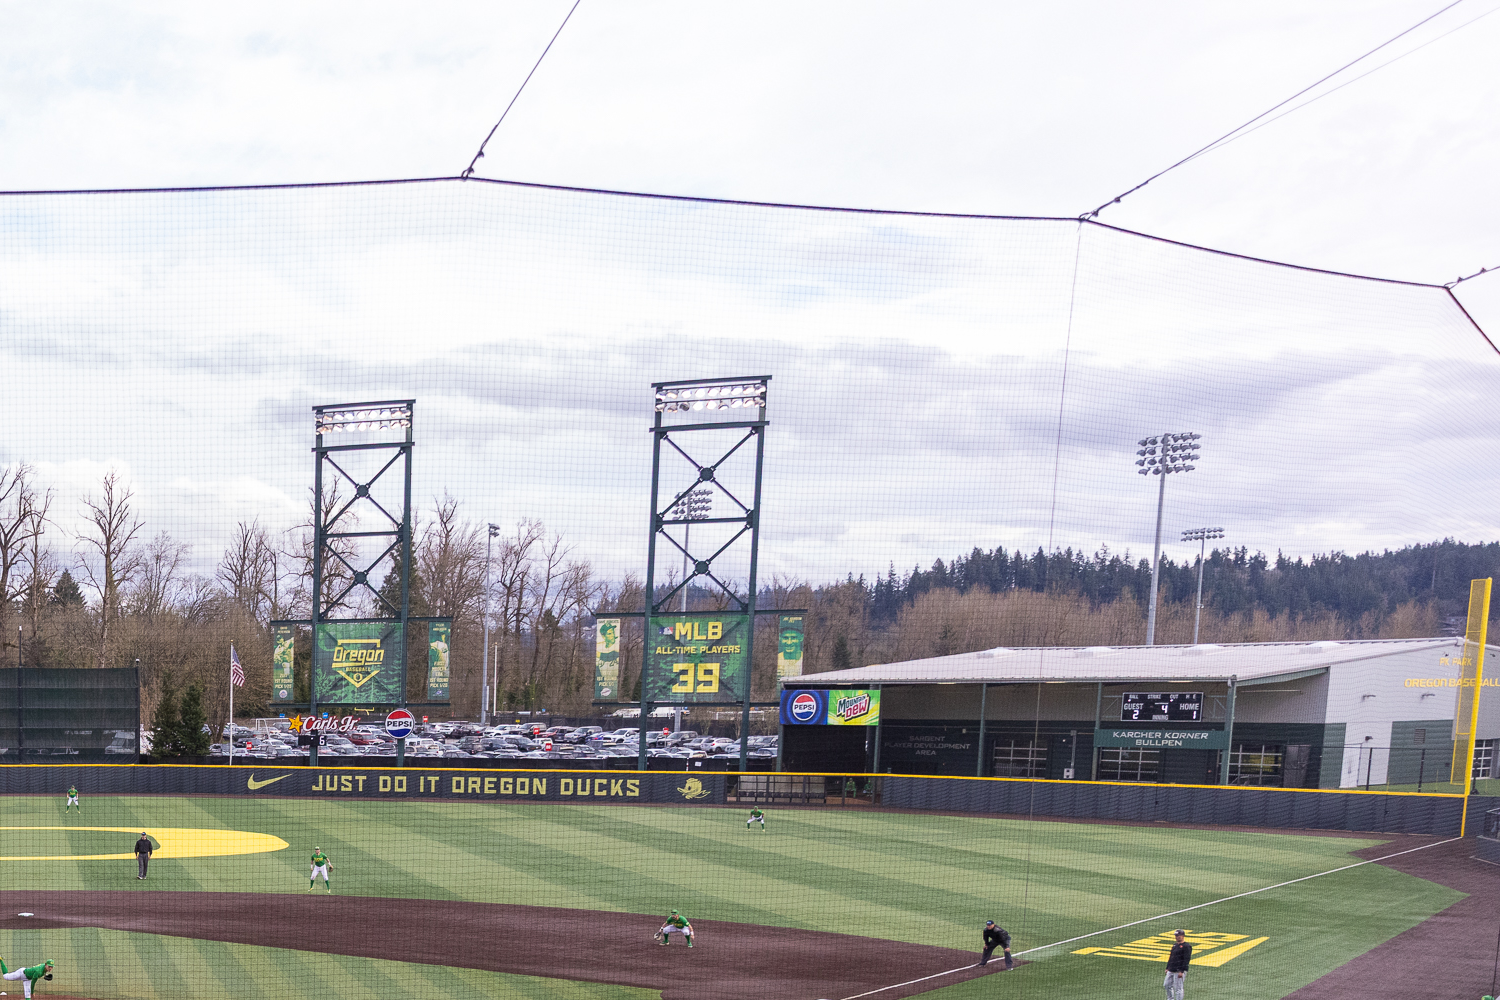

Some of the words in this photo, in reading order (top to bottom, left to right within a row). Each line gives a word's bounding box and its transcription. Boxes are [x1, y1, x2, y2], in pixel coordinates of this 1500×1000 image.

[675, 622, 723, 640] MLB
[656, 646, 697, 654] ALL-TIME
[700, 645, 740, 654] PLAYERS
[333, 646, 384, 666] Oregon
[1439, 658, 1450, 666] PK
[1452, 658, 1472, 666] PARK
[672, 663, 720, 692] 39
[1404, 678, 1447, 688] OREGON
[1448, 678, 1500, 688] BASEALL
[1124, 702, 1144, 710] GUEST
[1161, 705, 1168, 714] 4
[1132, 710, 1140, 720] 2
[1192, 710, 1196, 720] 1
[302, 716, 338, 732] Carl's
[386, 720, 412, 728] PEPSI
[319, 736, 325, 745] 6
[1164, 732, 1208, 740] KORNER
[914, 742, 970, 750] DEVELOPMENT
[312, 774, 367, 792] JUST
[378, 776, 406, 792] DO
[418, 776, 440, 793] IT
[452, 776, 547, 795] OREGON
[560, 778, 640, 797] DUCKS
